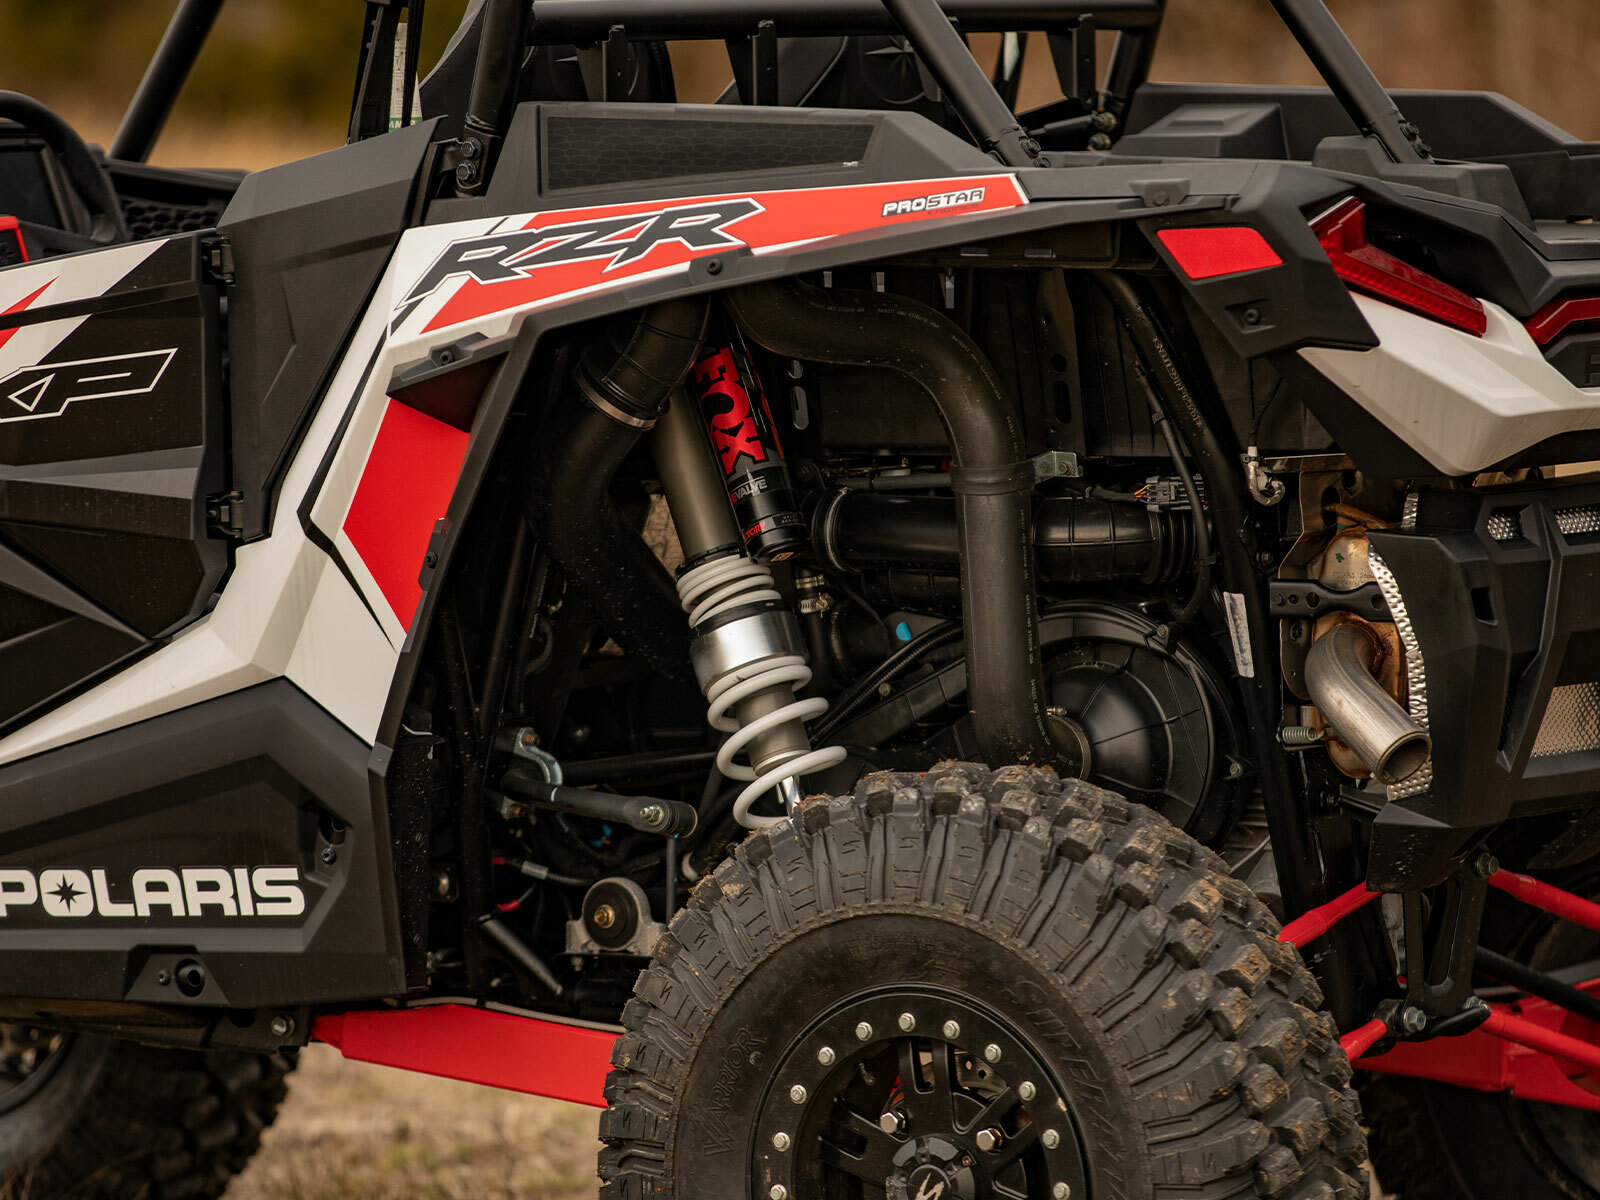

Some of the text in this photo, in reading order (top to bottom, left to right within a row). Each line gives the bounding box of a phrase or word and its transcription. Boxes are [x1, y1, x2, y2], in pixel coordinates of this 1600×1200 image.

[394, 197, 766, 311] RZR
[881, 187, 985, 217] PROSTAR
[692, 347, 766, 476] FOX
[0, 867, 305, 917] POLARIS
[697, 1027, 767, 1157] WARRIOR
